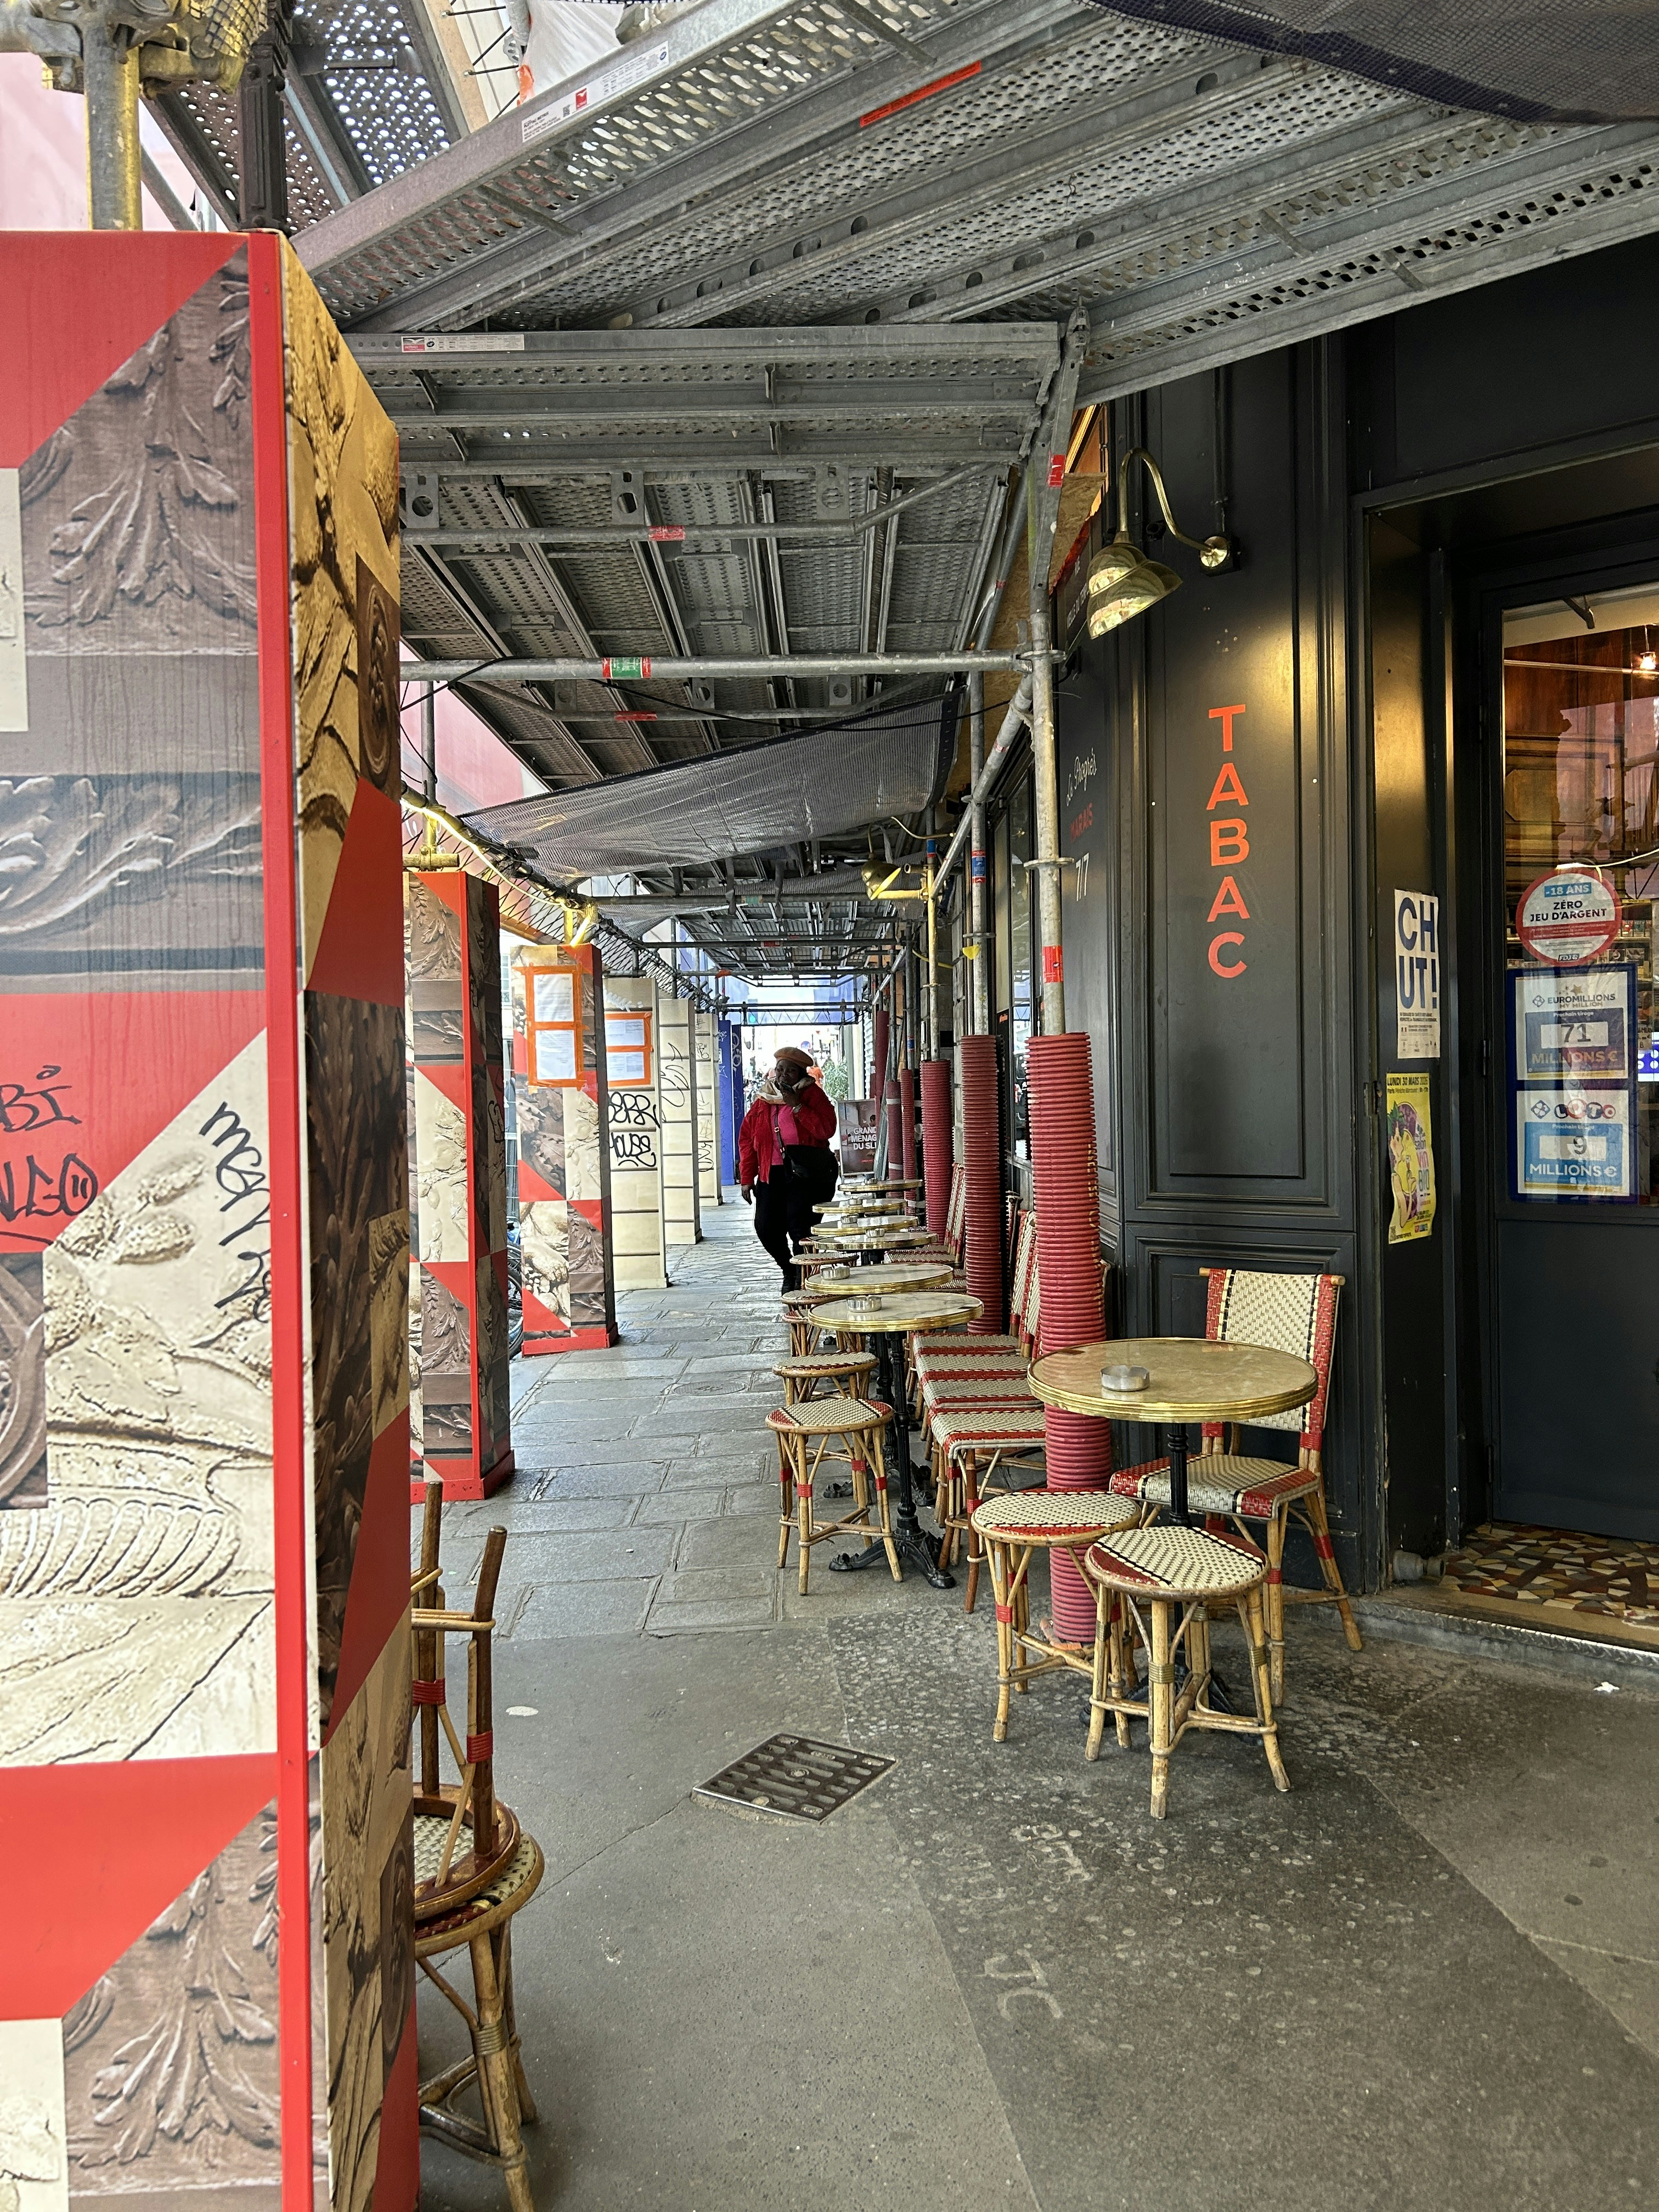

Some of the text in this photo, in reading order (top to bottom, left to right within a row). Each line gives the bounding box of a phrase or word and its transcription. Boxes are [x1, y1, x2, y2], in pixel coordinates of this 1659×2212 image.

[1206, 703, 1250, 979] TABAC
[1566, 884, 1590, 894] ANS
[1554, 900, 1583, 910] ZÉRO
[1530, 909, 1607, 922] JEU D'ARGENT
[1398, 897, 1436, 953] CH
[1399, 955, 1437, 1009] UT!
[1547, 994, 1616, 1005] EUROMILLIONS
[1560, 1024, 1592, 1043] 71
[1532, 1050, 1618, 1064] MILLIONS €
[1387, 1077, 1402, 1086] LUNDI
[1554, 1098, 1616, 1120] LOTO
[853, 1127, 877, 1135] GRAND
[1573, 1135, 1588, 1155] 9
[1530, 1163, 1617, 1177] MILLIONS €
[1418, 1169, 1430, 1192] BIO
